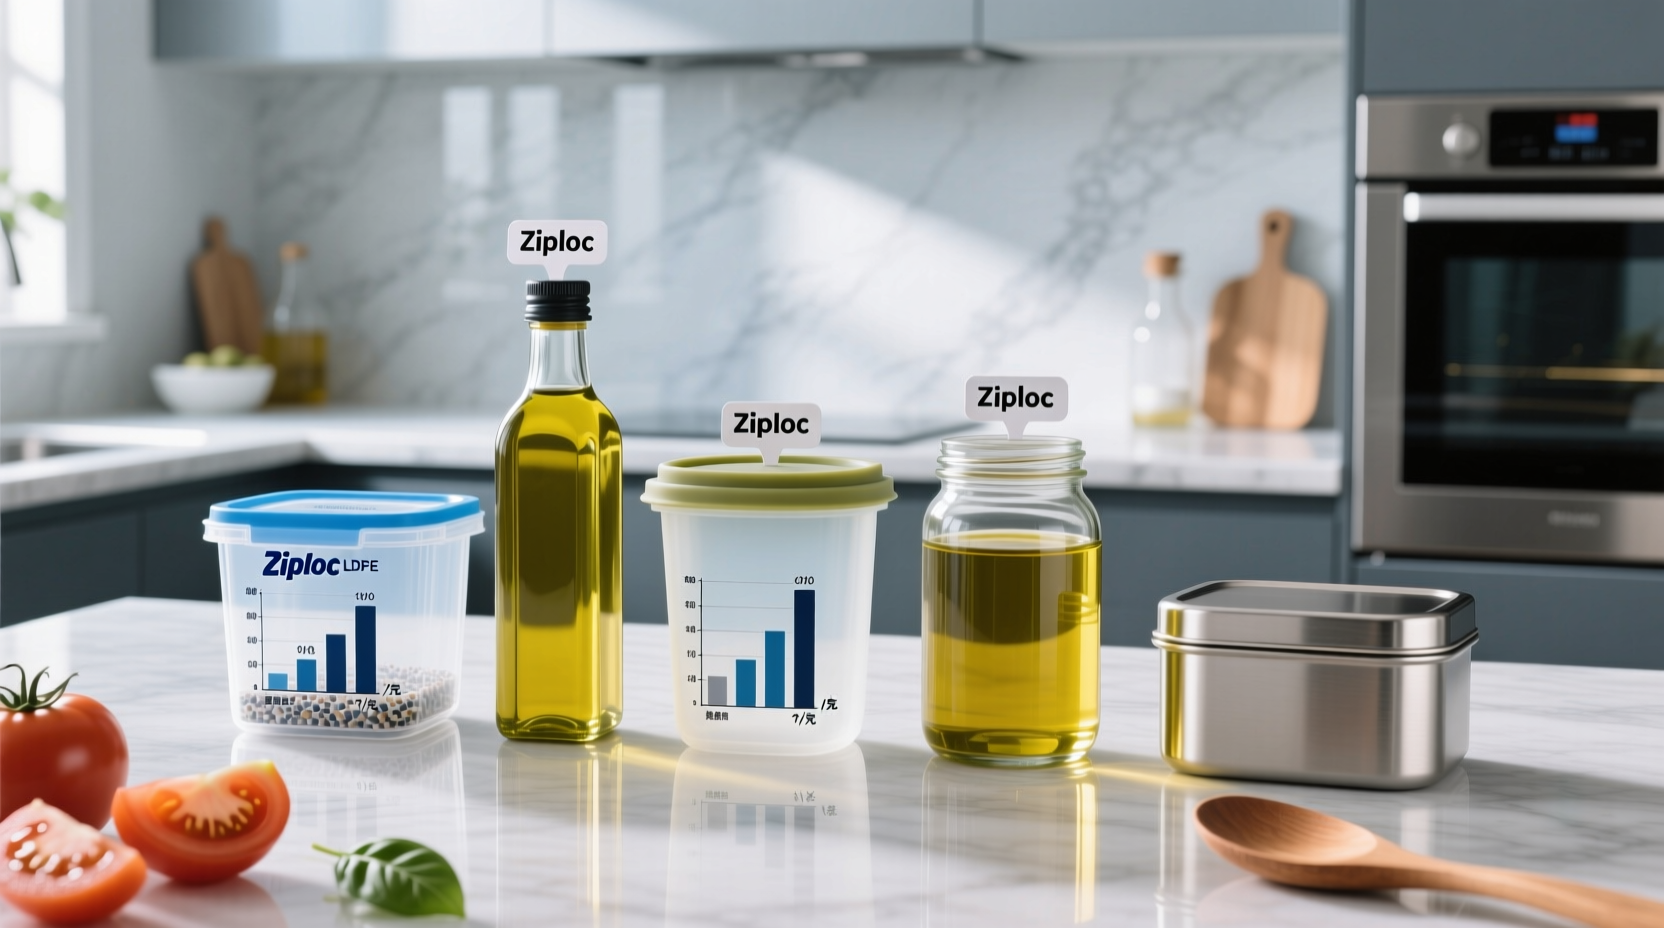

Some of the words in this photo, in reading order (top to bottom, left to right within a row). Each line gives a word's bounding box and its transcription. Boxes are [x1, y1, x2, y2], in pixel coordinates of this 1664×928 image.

[520, 229, 595, 257] Ziploc
[977, 385, 1054, 412] Ziploc
[733, 411, 809, 438] Ziploc
[262, 550, 341, 581] Ziploc
